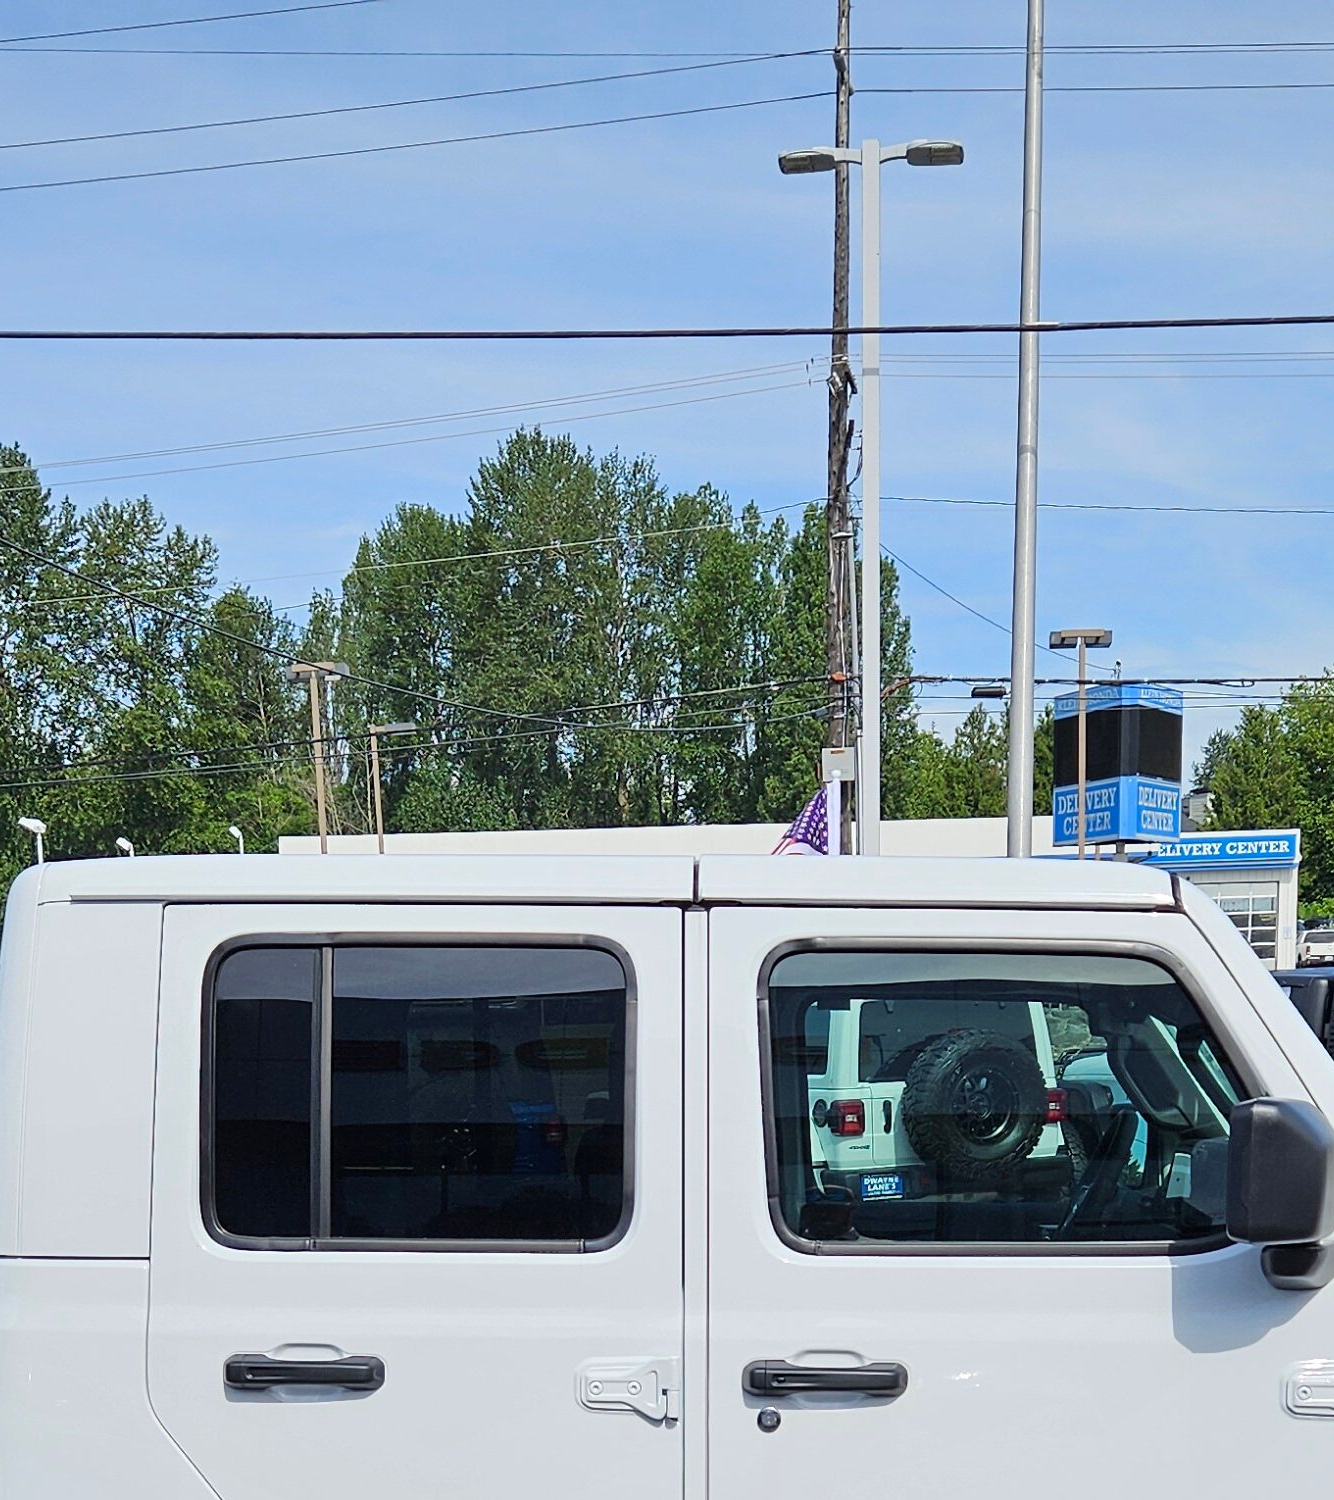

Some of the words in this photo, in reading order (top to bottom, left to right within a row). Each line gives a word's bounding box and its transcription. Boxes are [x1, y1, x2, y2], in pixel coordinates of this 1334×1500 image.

[1057, 787, 1117, 814] DELVERY
[1138, 786, 1179, 810] DELIVERY
[1141, 810, 1174, 832] CENTER
[1158, 843, 1222, 857] ELIVERY
[1226, 841, 1290, 854] CENTER
[864, 1175, 899, 1185] DWAYNE
